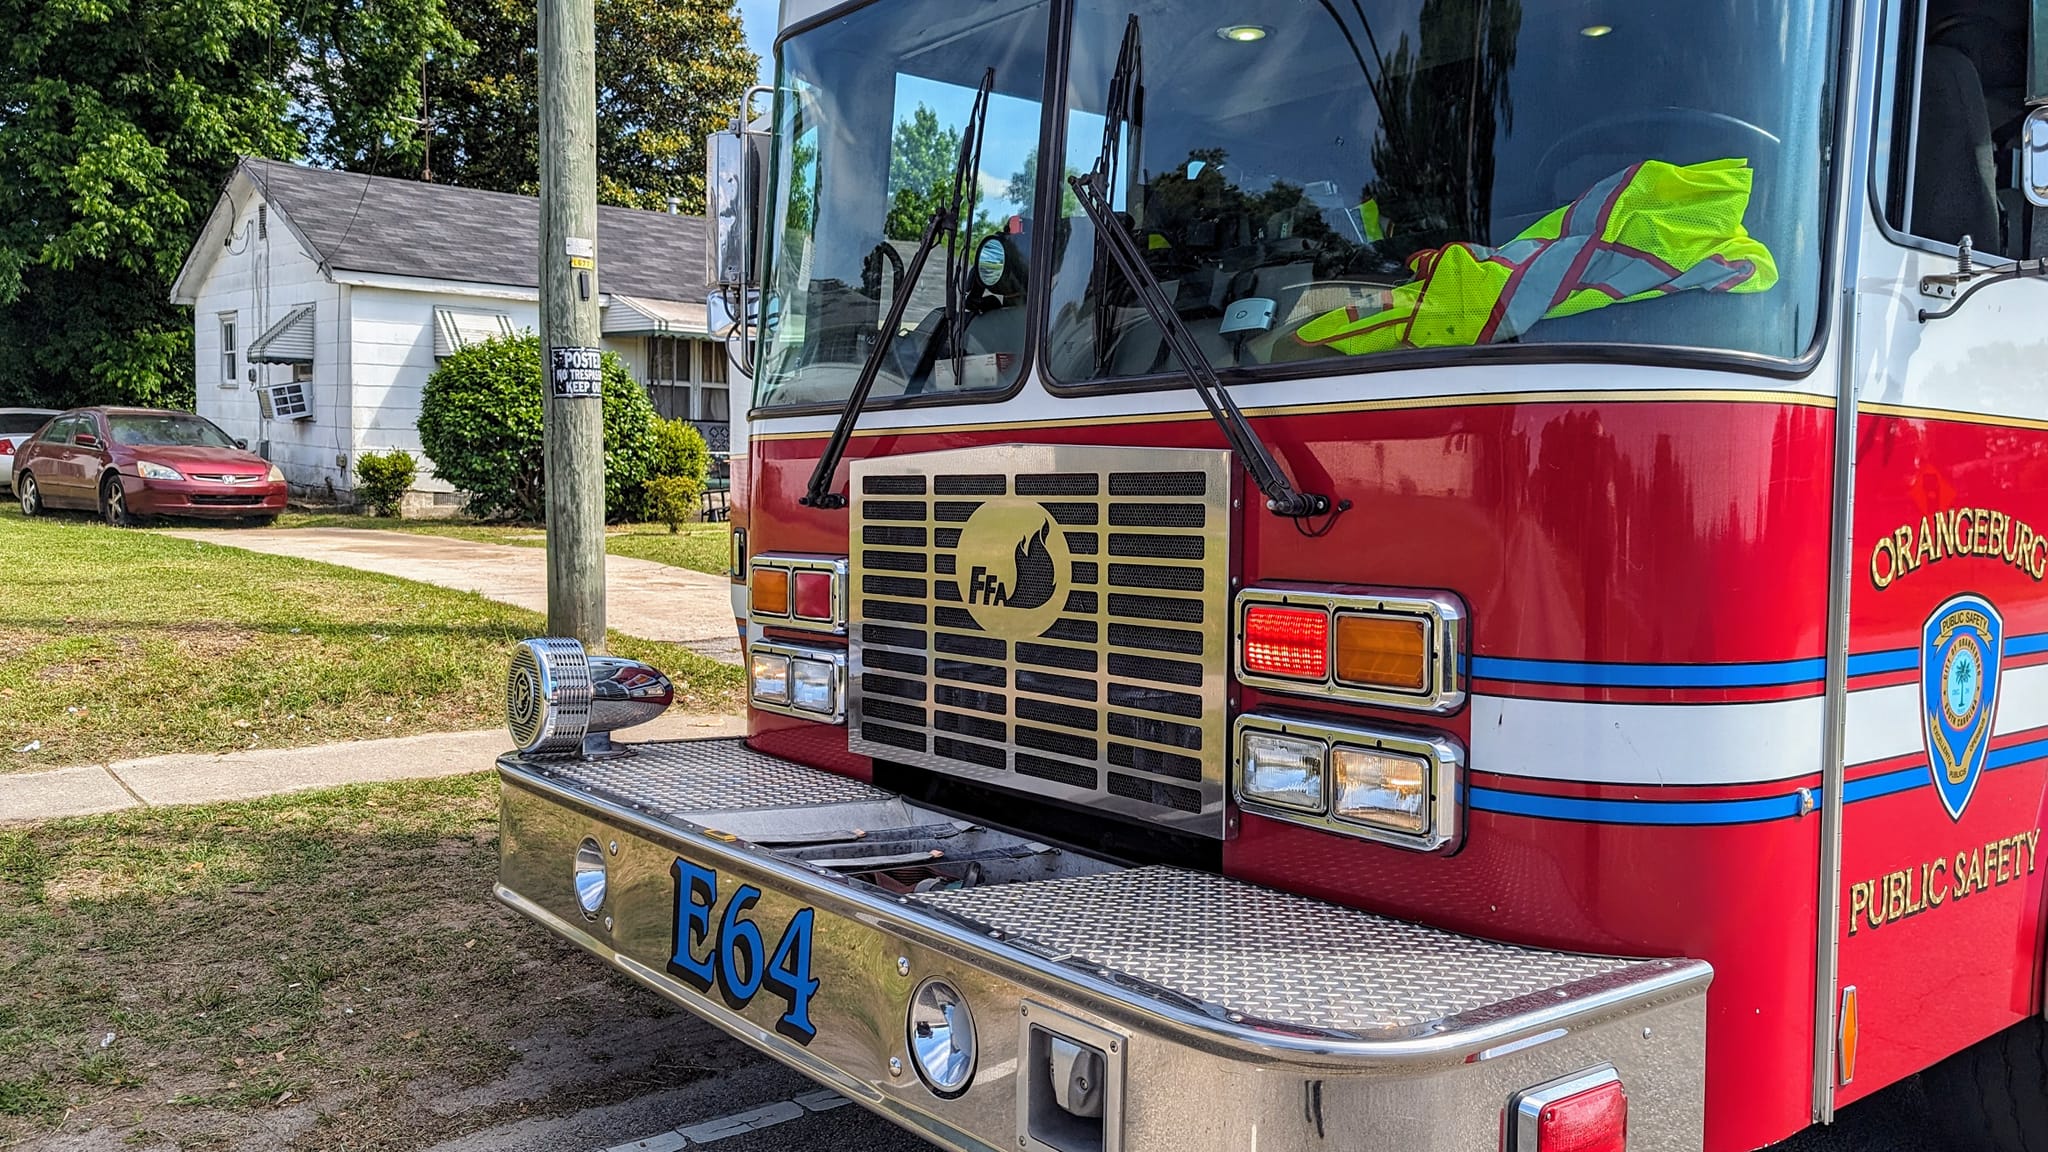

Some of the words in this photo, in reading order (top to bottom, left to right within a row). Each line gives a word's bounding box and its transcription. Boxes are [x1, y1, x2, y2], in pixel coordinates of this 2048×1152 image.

[556, 368, 568, 382] NO
[565, 380, 590, 394] KEEP
[1870, 507, 2048, 591] ORANGEBURG
[969, 566, 1007, 606] FFA
[1941, 611, 1964, 632] PUBLIC
[1965, 611, 1988, 630] SAFETY
[1848, 857, 1949, 938] PUBLIC
[1952, 828, 2041, 902] SAFETY
[667, 856, 820, 1046] E64
